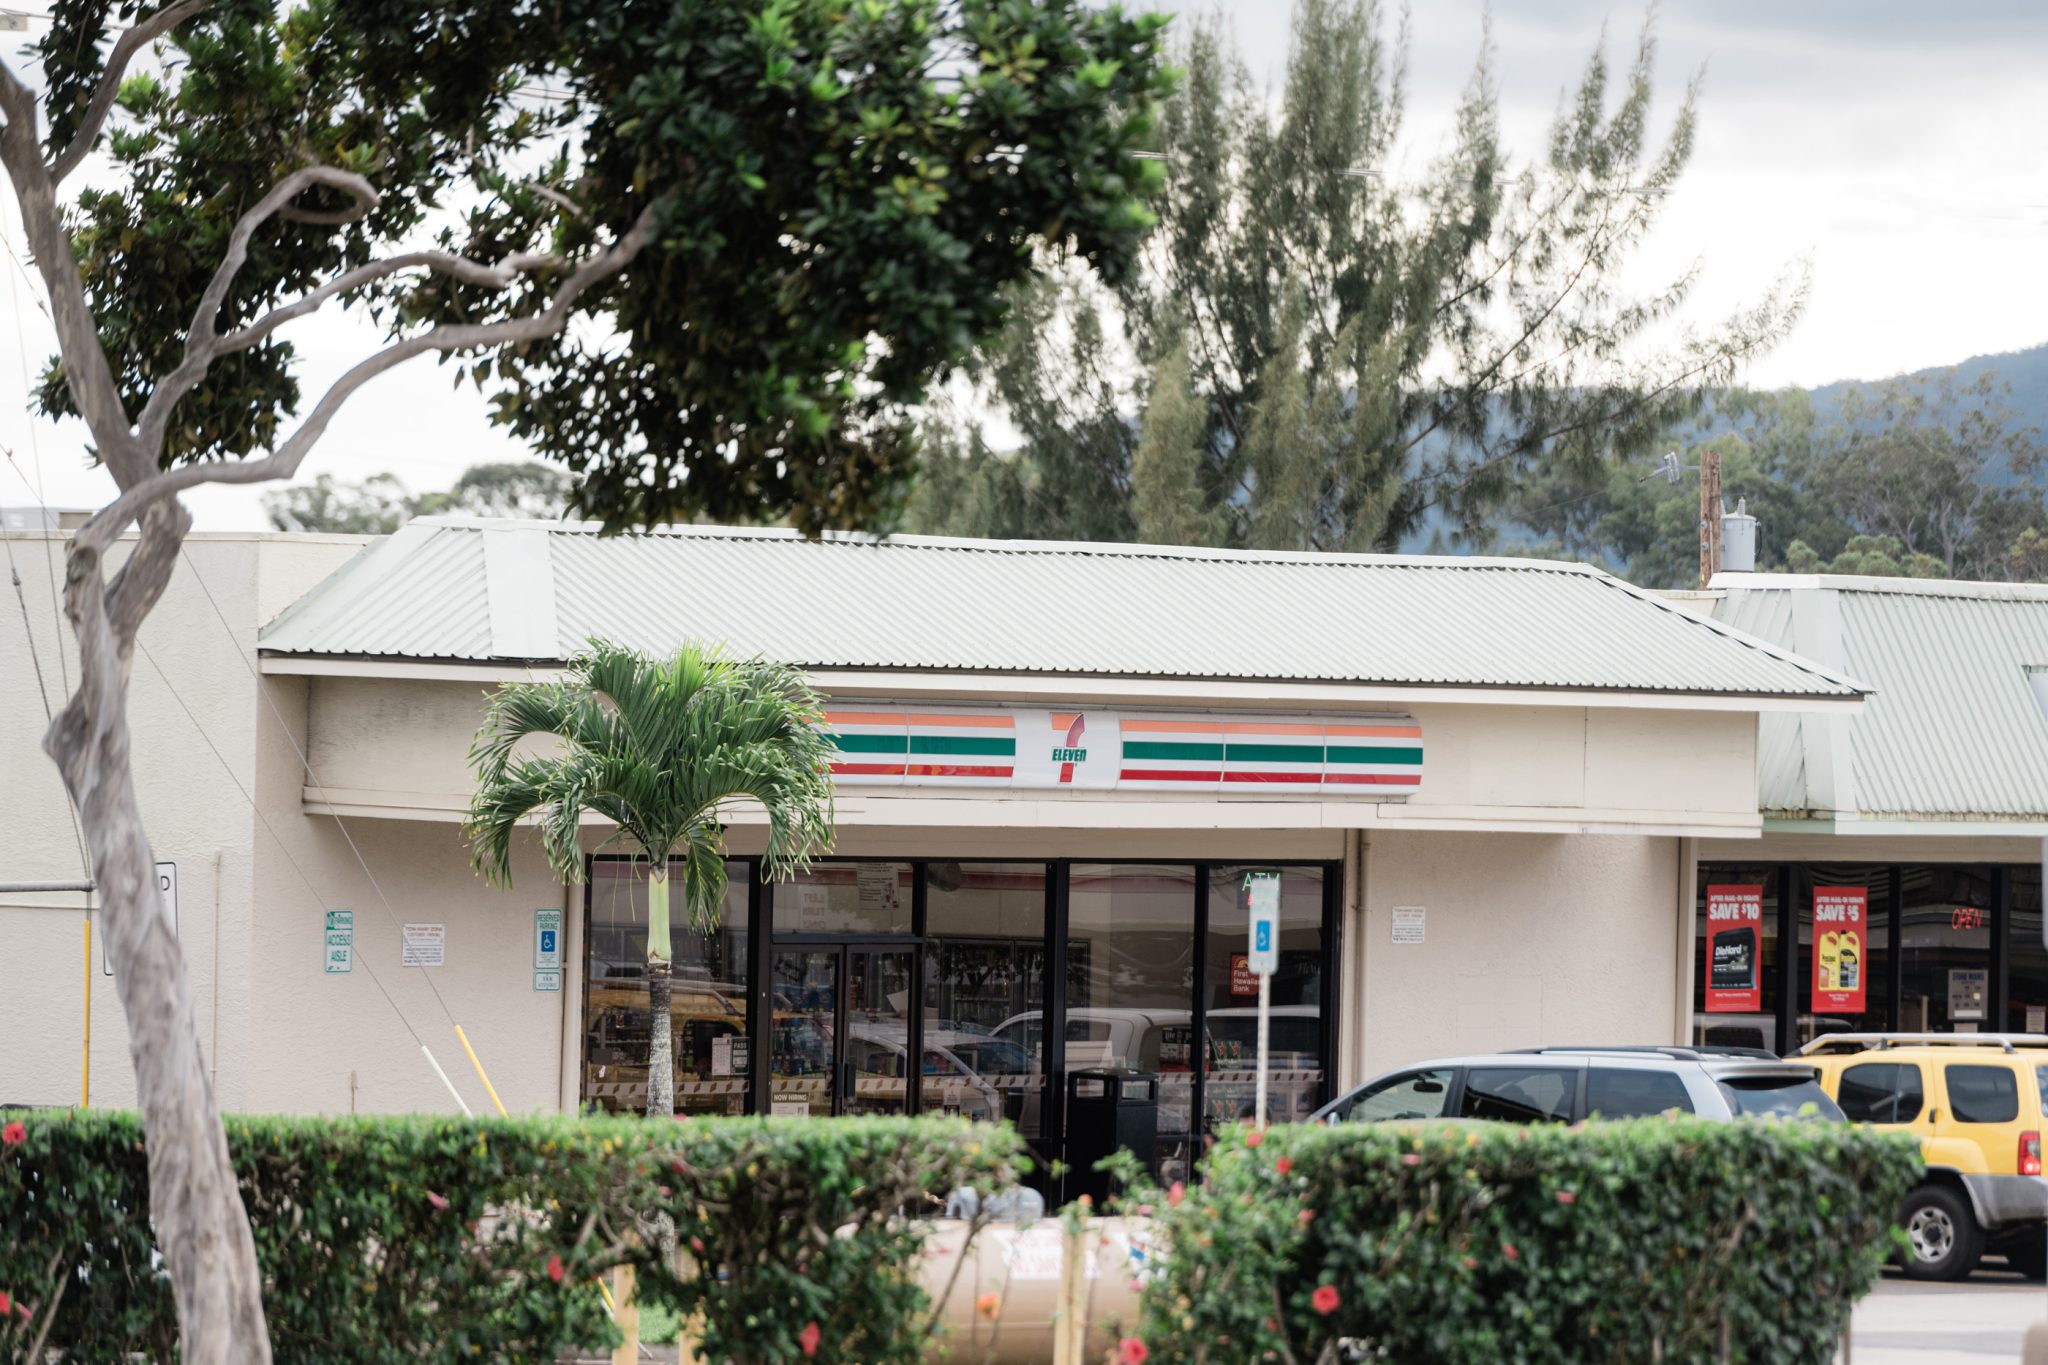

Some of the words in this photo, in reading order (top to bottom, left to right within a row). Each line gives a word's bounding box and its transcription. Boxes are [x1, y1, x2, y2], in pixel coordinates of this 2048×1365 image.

[1709, 903, 1740, 920] SAVE
[1741, 903, 1760, 920] $10
[1816, 904, 1845, 922] SAVE
[1847, 904, 1860, 922] $5
[1951, 908, 1983, 930] OPEN
[327, 934, 352, 946] ACCESS
[330, 950, 347, 962] AISLE
[1714, 943, 1743, 957] DieHard
[1233, 977, 1262, 986] Hawaiia
